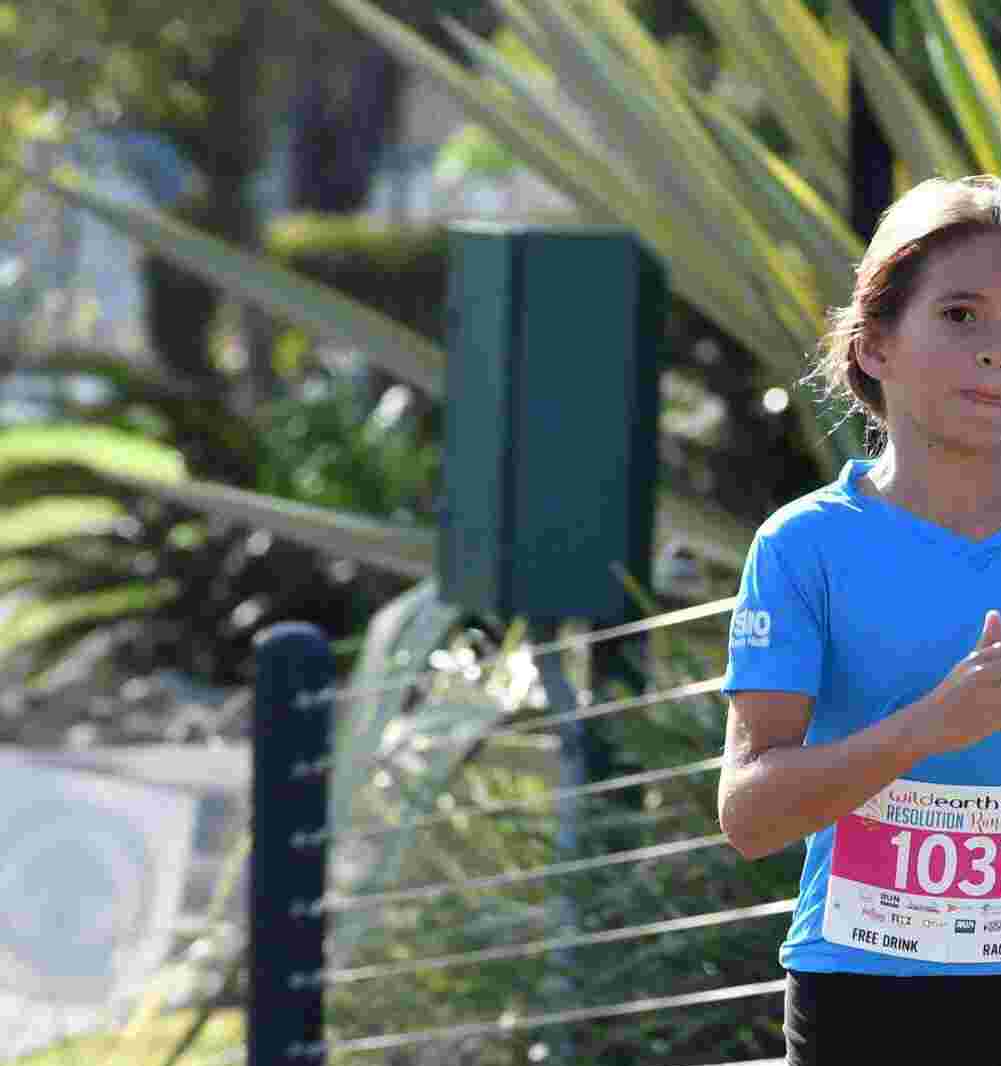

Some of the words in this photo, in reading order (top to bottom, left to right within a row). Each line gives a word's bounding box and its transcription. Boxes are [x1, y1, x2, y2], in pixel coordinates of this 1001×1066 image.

[886, 804, 964, 829] RESOLUTION
[852, 927, 879, 944] FREE
[882, 934, 919, 952] DRINK
